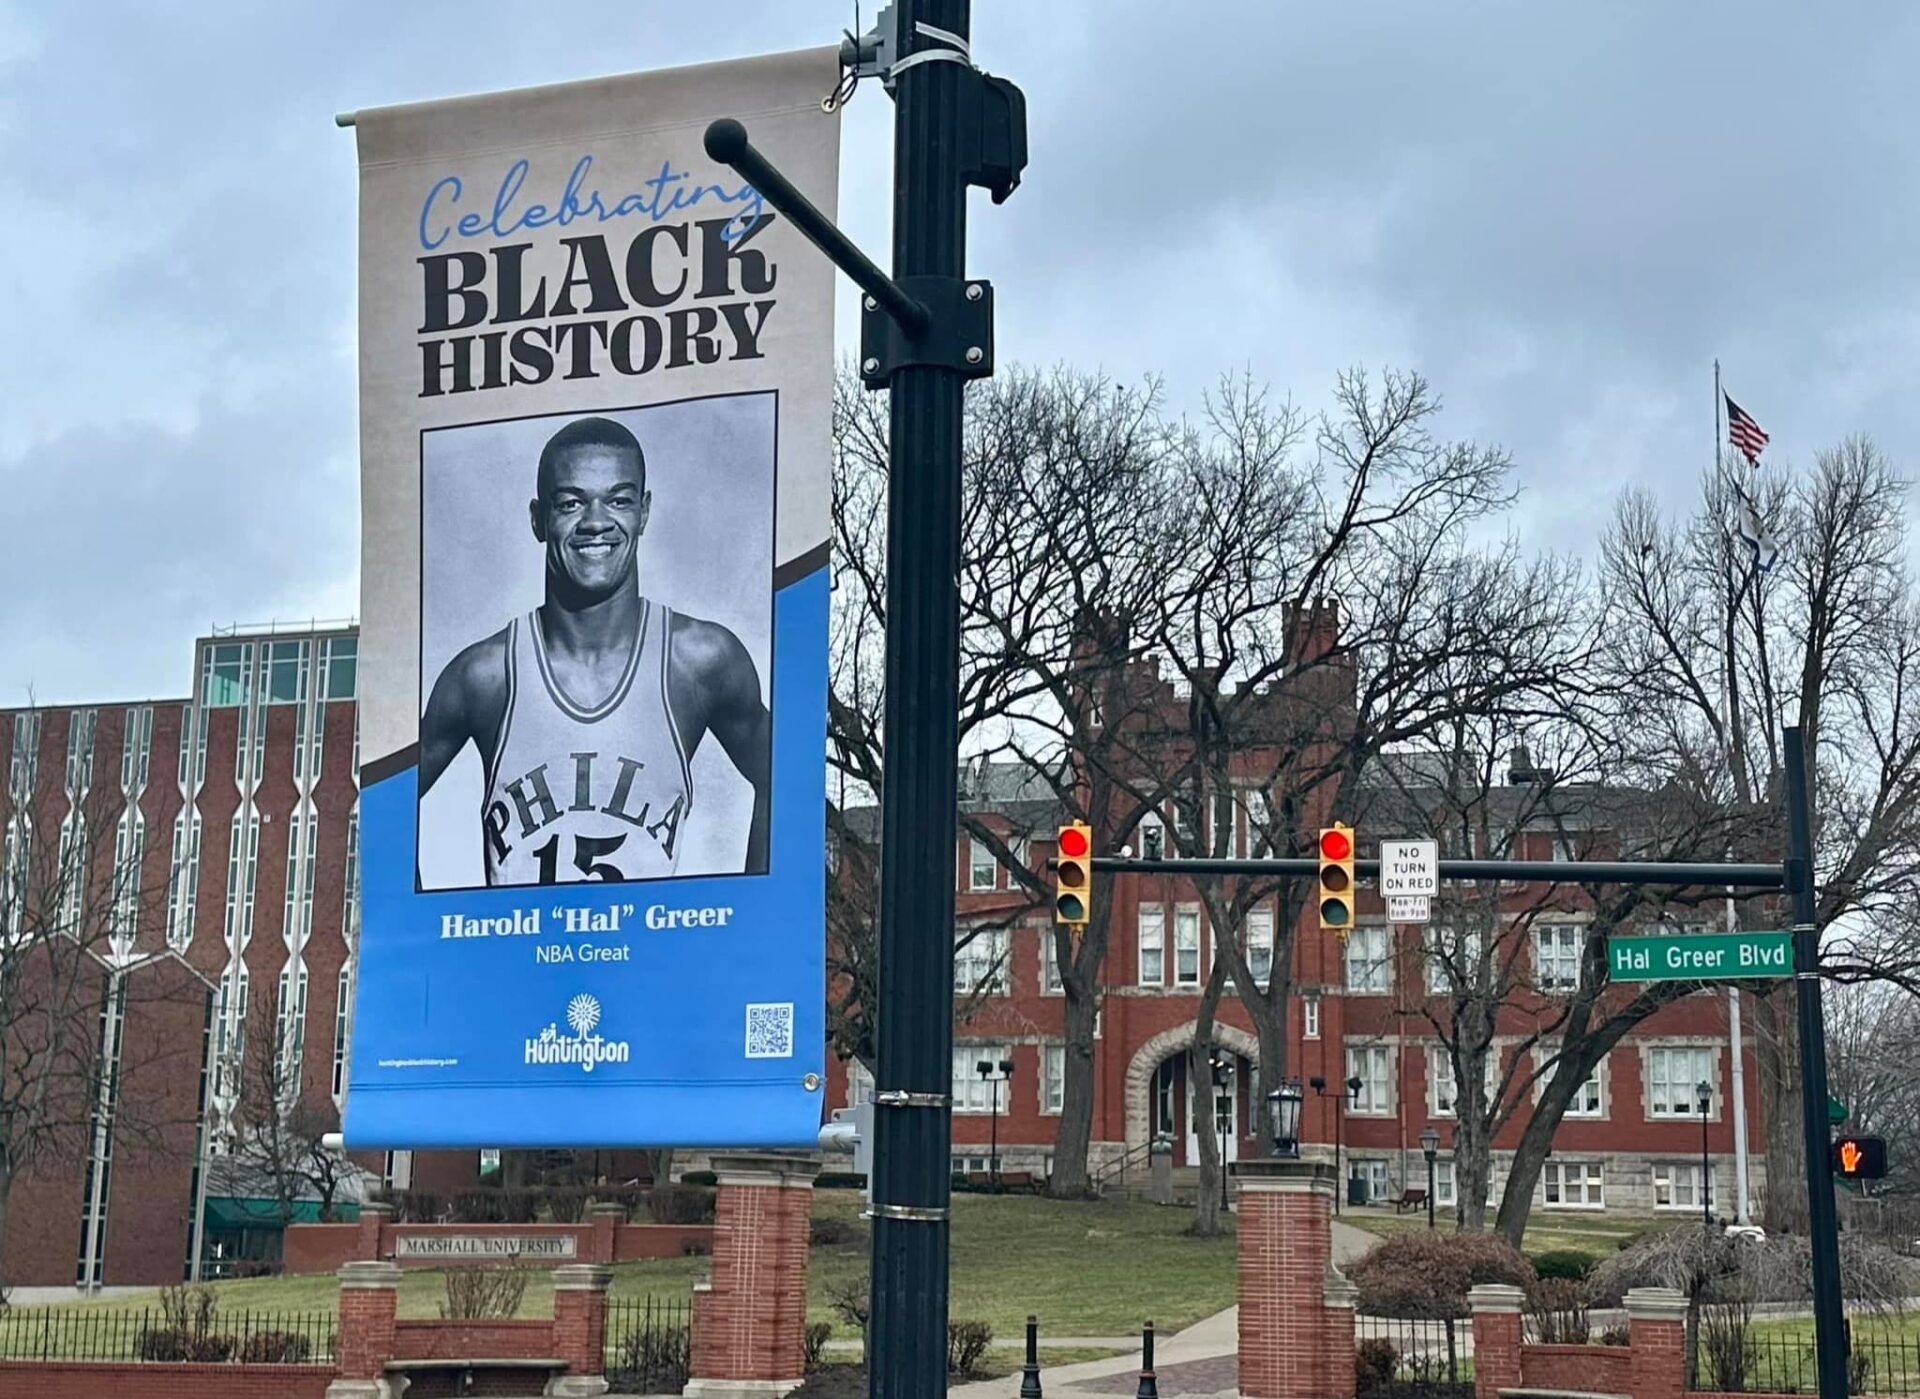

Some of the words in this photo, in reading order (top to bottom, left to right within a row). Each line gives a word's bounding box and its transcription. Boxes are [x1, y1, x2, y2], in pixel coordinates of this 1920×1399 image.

[418, 154, 763, 250] Celebrating
[416, 212, 777, 334] BLACK
[417, 300, 777, 398] HISTORY
[483, 752, 685, 866] PHILA
[532, 832, 629, 884] 15
[1393, 863, 1426, 874] TURN
[1398, 847, 1420, 858] NO
[1386, 878, 1403, 889] ON
[1408, 877, 1433, 889] RED
[440, 908, 541, 938] Harold
[552, 904, 635, 933] “Hal”
[645, 903, 734, 930] Greer
[536, 944, 575, 964] NBA
[578, 943, 630, 962] Great
[1617, 948, 1649, 970] Hal
[1666, 946, 1725, 968] Greer
[1739, 943, 1785, 966] Blvd
[524, 1034, 629, 1072] Huntington
[406, 1239, 477, 1253] MARSHALL
[484, 1239, 566, 1253] UNIVERSITY
